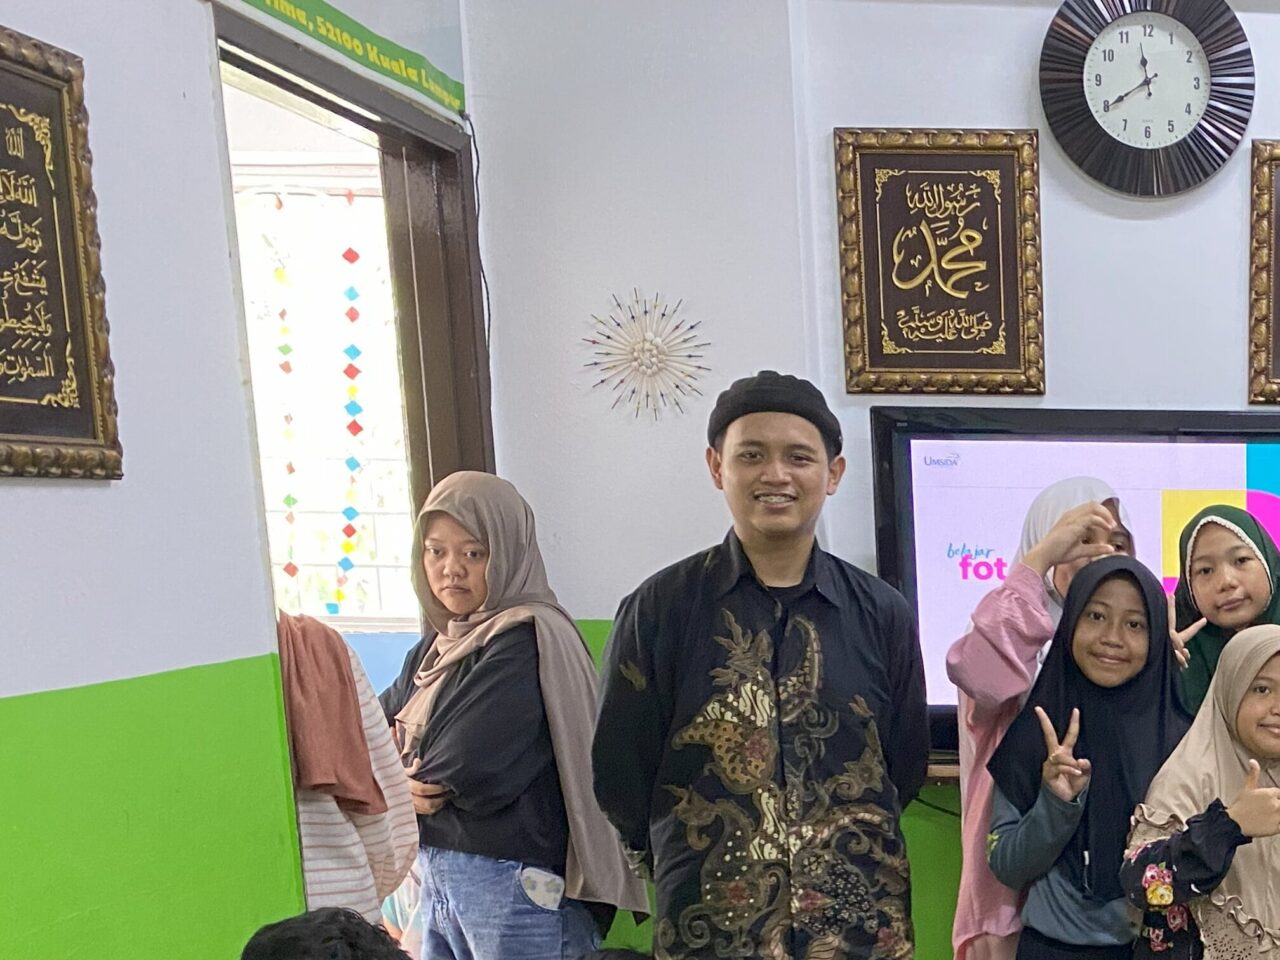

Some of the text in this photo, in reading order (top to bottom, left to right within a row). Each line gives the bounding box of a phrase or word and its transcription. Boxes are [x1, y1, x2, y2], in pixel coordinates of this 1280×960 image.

[1143, 24, 1154, 37] 12
[1119, 31, 1129, 44] 11
[1168, 32, 1174, 45] 1
[316, 16, 363, 56] 52100
[366, 43, 418, 81] Kuala
[1102, 49, 1114, 62] 10
[1186, 51, 1193, 63] 2
[1095, 74, 1102, 87] 9
[1194, 77, 1200, 90] 3
[1103, 100, 1110, 113] 8
[1185, 103, 1192, 115] 4
[1122, 119, 1128, 132] 7
[1167, 120, 1174, 133] 5
[1144, 126, 1151, 139] 6
[947, 542, 995, 560] belajar
